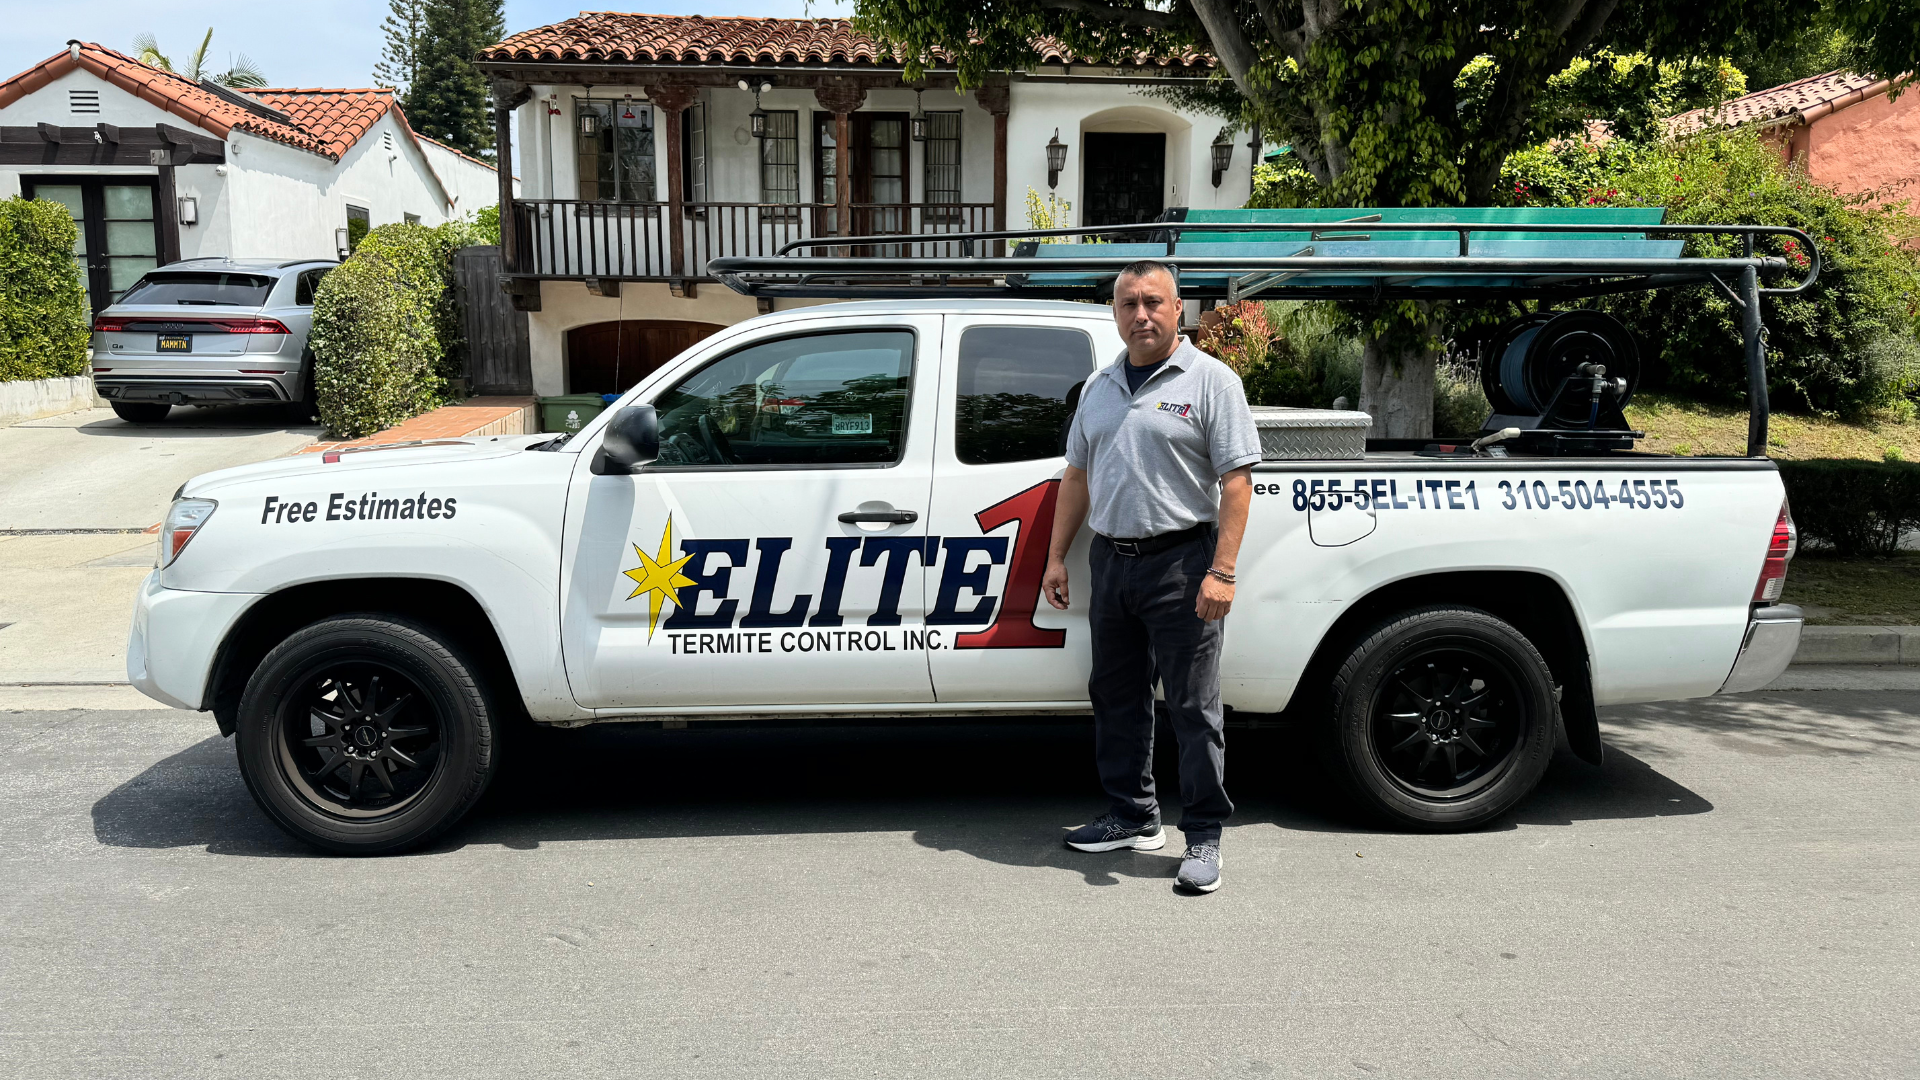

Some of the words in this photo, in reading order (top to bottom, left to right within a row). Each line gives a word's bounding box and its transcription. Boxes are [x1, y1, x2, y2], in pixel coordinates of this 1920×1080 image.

[261, 496, 318, 524] Free
[326, 491, 457, 521] Estimates
[1253, 482, 1281, 496] ee
[1292, 478, 1481, 512] 855-5EL-ITE1
[1498, 479, 1685, 511] 310-504-4555
[667, 632, 772, 655] TERMITE
[780, 630, 896, 653] CONTROL
[903, 629, 948, 651] INC.
